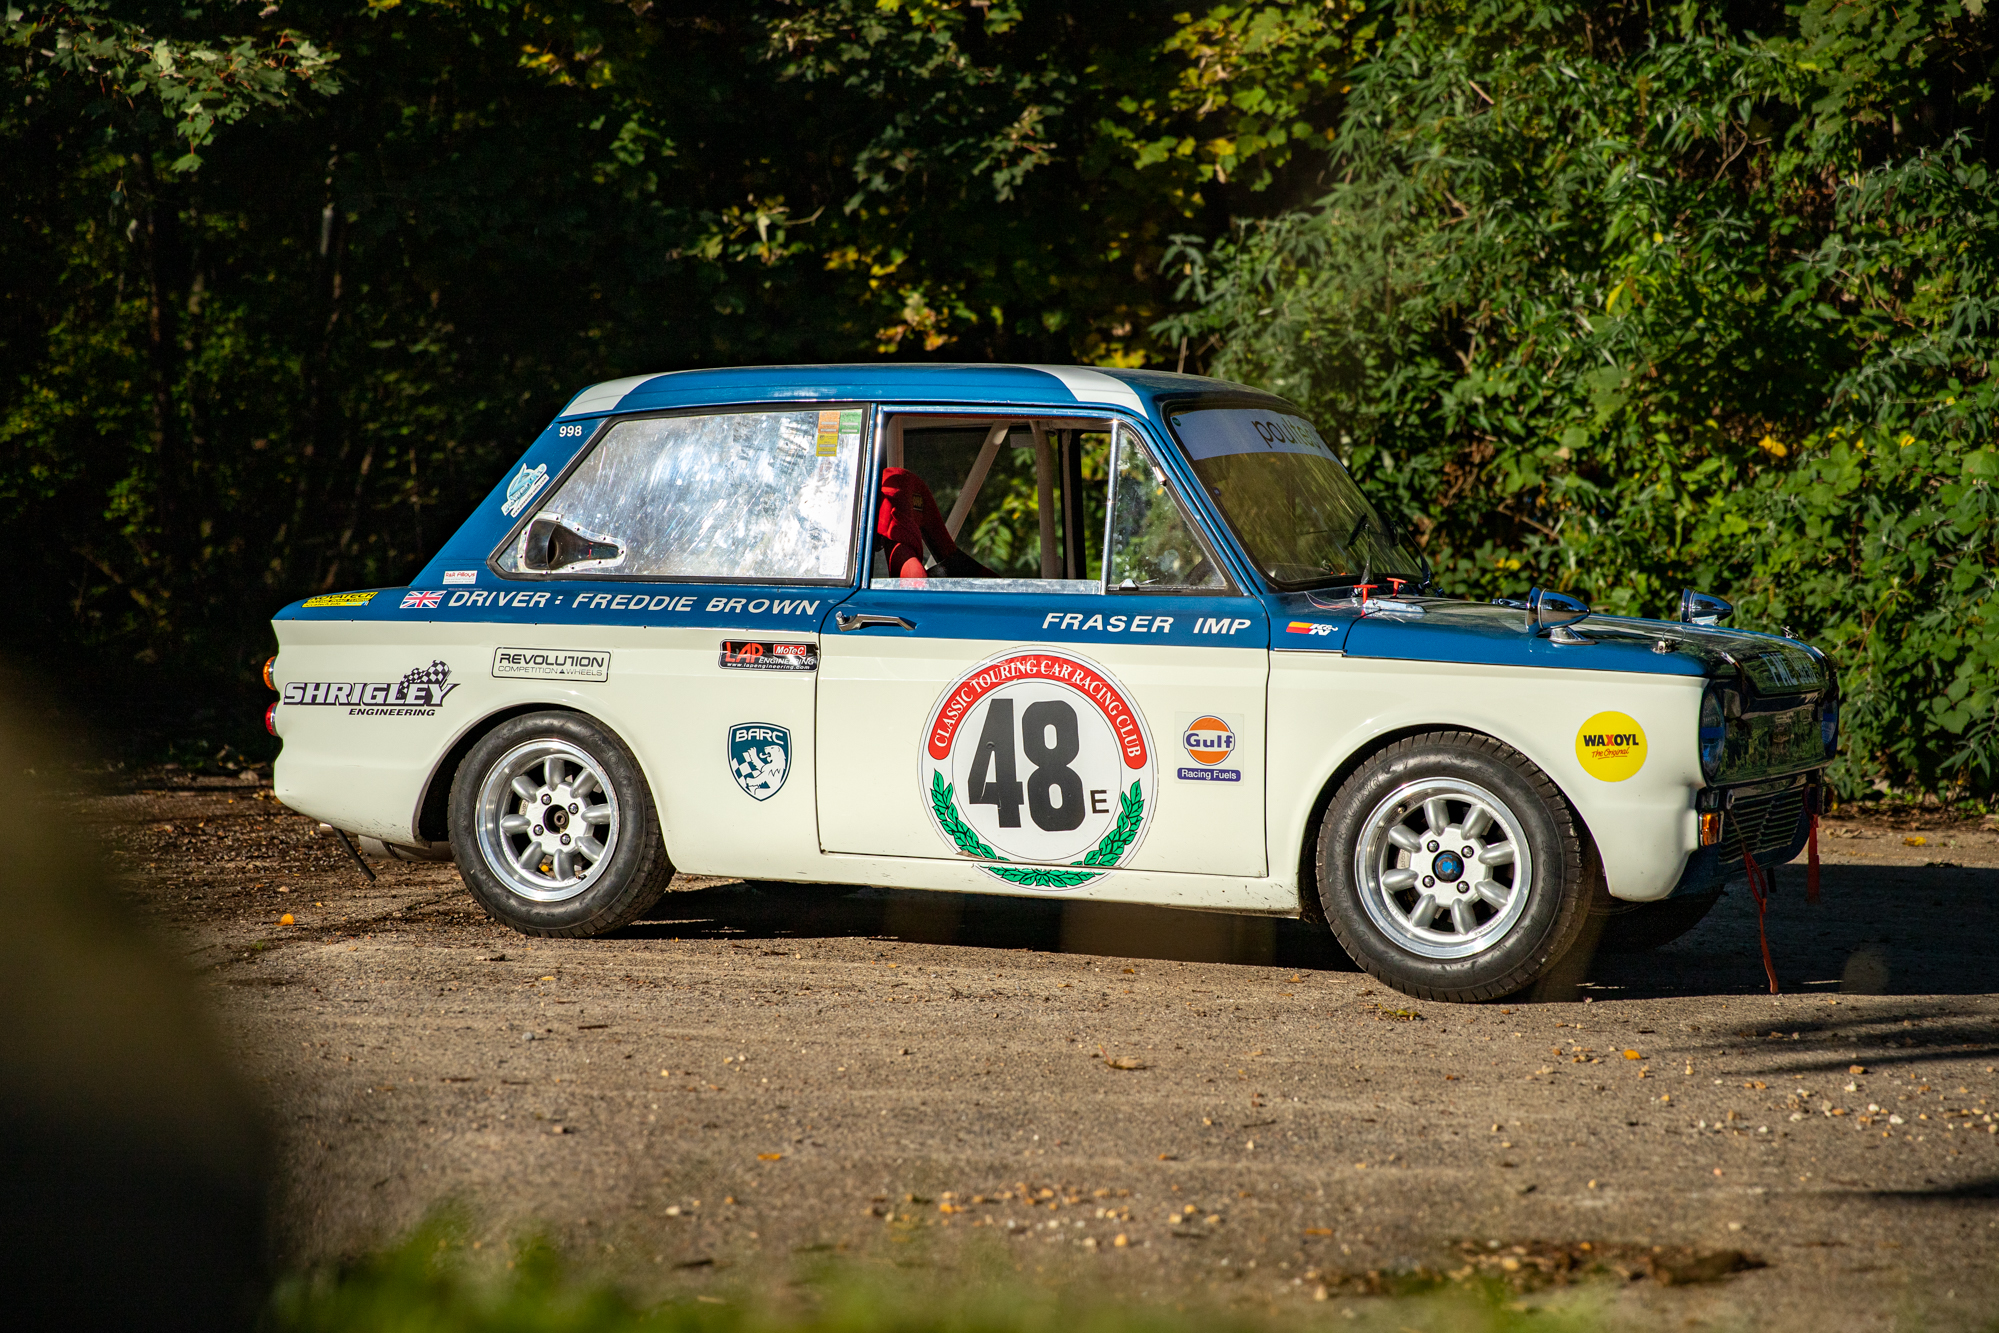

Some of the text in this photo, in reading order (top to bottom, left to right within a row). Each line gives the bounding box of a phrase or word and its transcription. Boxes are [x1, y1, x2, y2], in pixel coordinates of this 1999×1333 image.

[559, 425, 582, 438] 998
[572, 593, 698, 611] FREDDIE
[705, 597, 820, 615] BROWN
[1042, 612, 1251, 635] FRASER IMP
[725, 641, 763, 663] LAP
[775, 646, 804, 655] MoTeC
[499, 653, 605, 668] REVOLUTION
[758, 657, 816, 666] ENGINEERING
[498, 665, 558, 674] COMPETITION
[284, 682, 461, 707] SHRIGLEY
[349, 708, 436, 717] ENGINEERING
[934, 660, 1141, 757] CLASSIC TOURING CAR RACING CLUB
[735, 728, 784, 744] BARC
[1186, 733, 1233, 749] Gulf
[1583, 734, 1639, 747] WAXOYL
[1592, 746, 1630, 759] The Original
[968, 698, 1086, 832] 48
[1181, 768, 1237, 780] Racing Fuels
[1090, 790, 1110, 814] E
